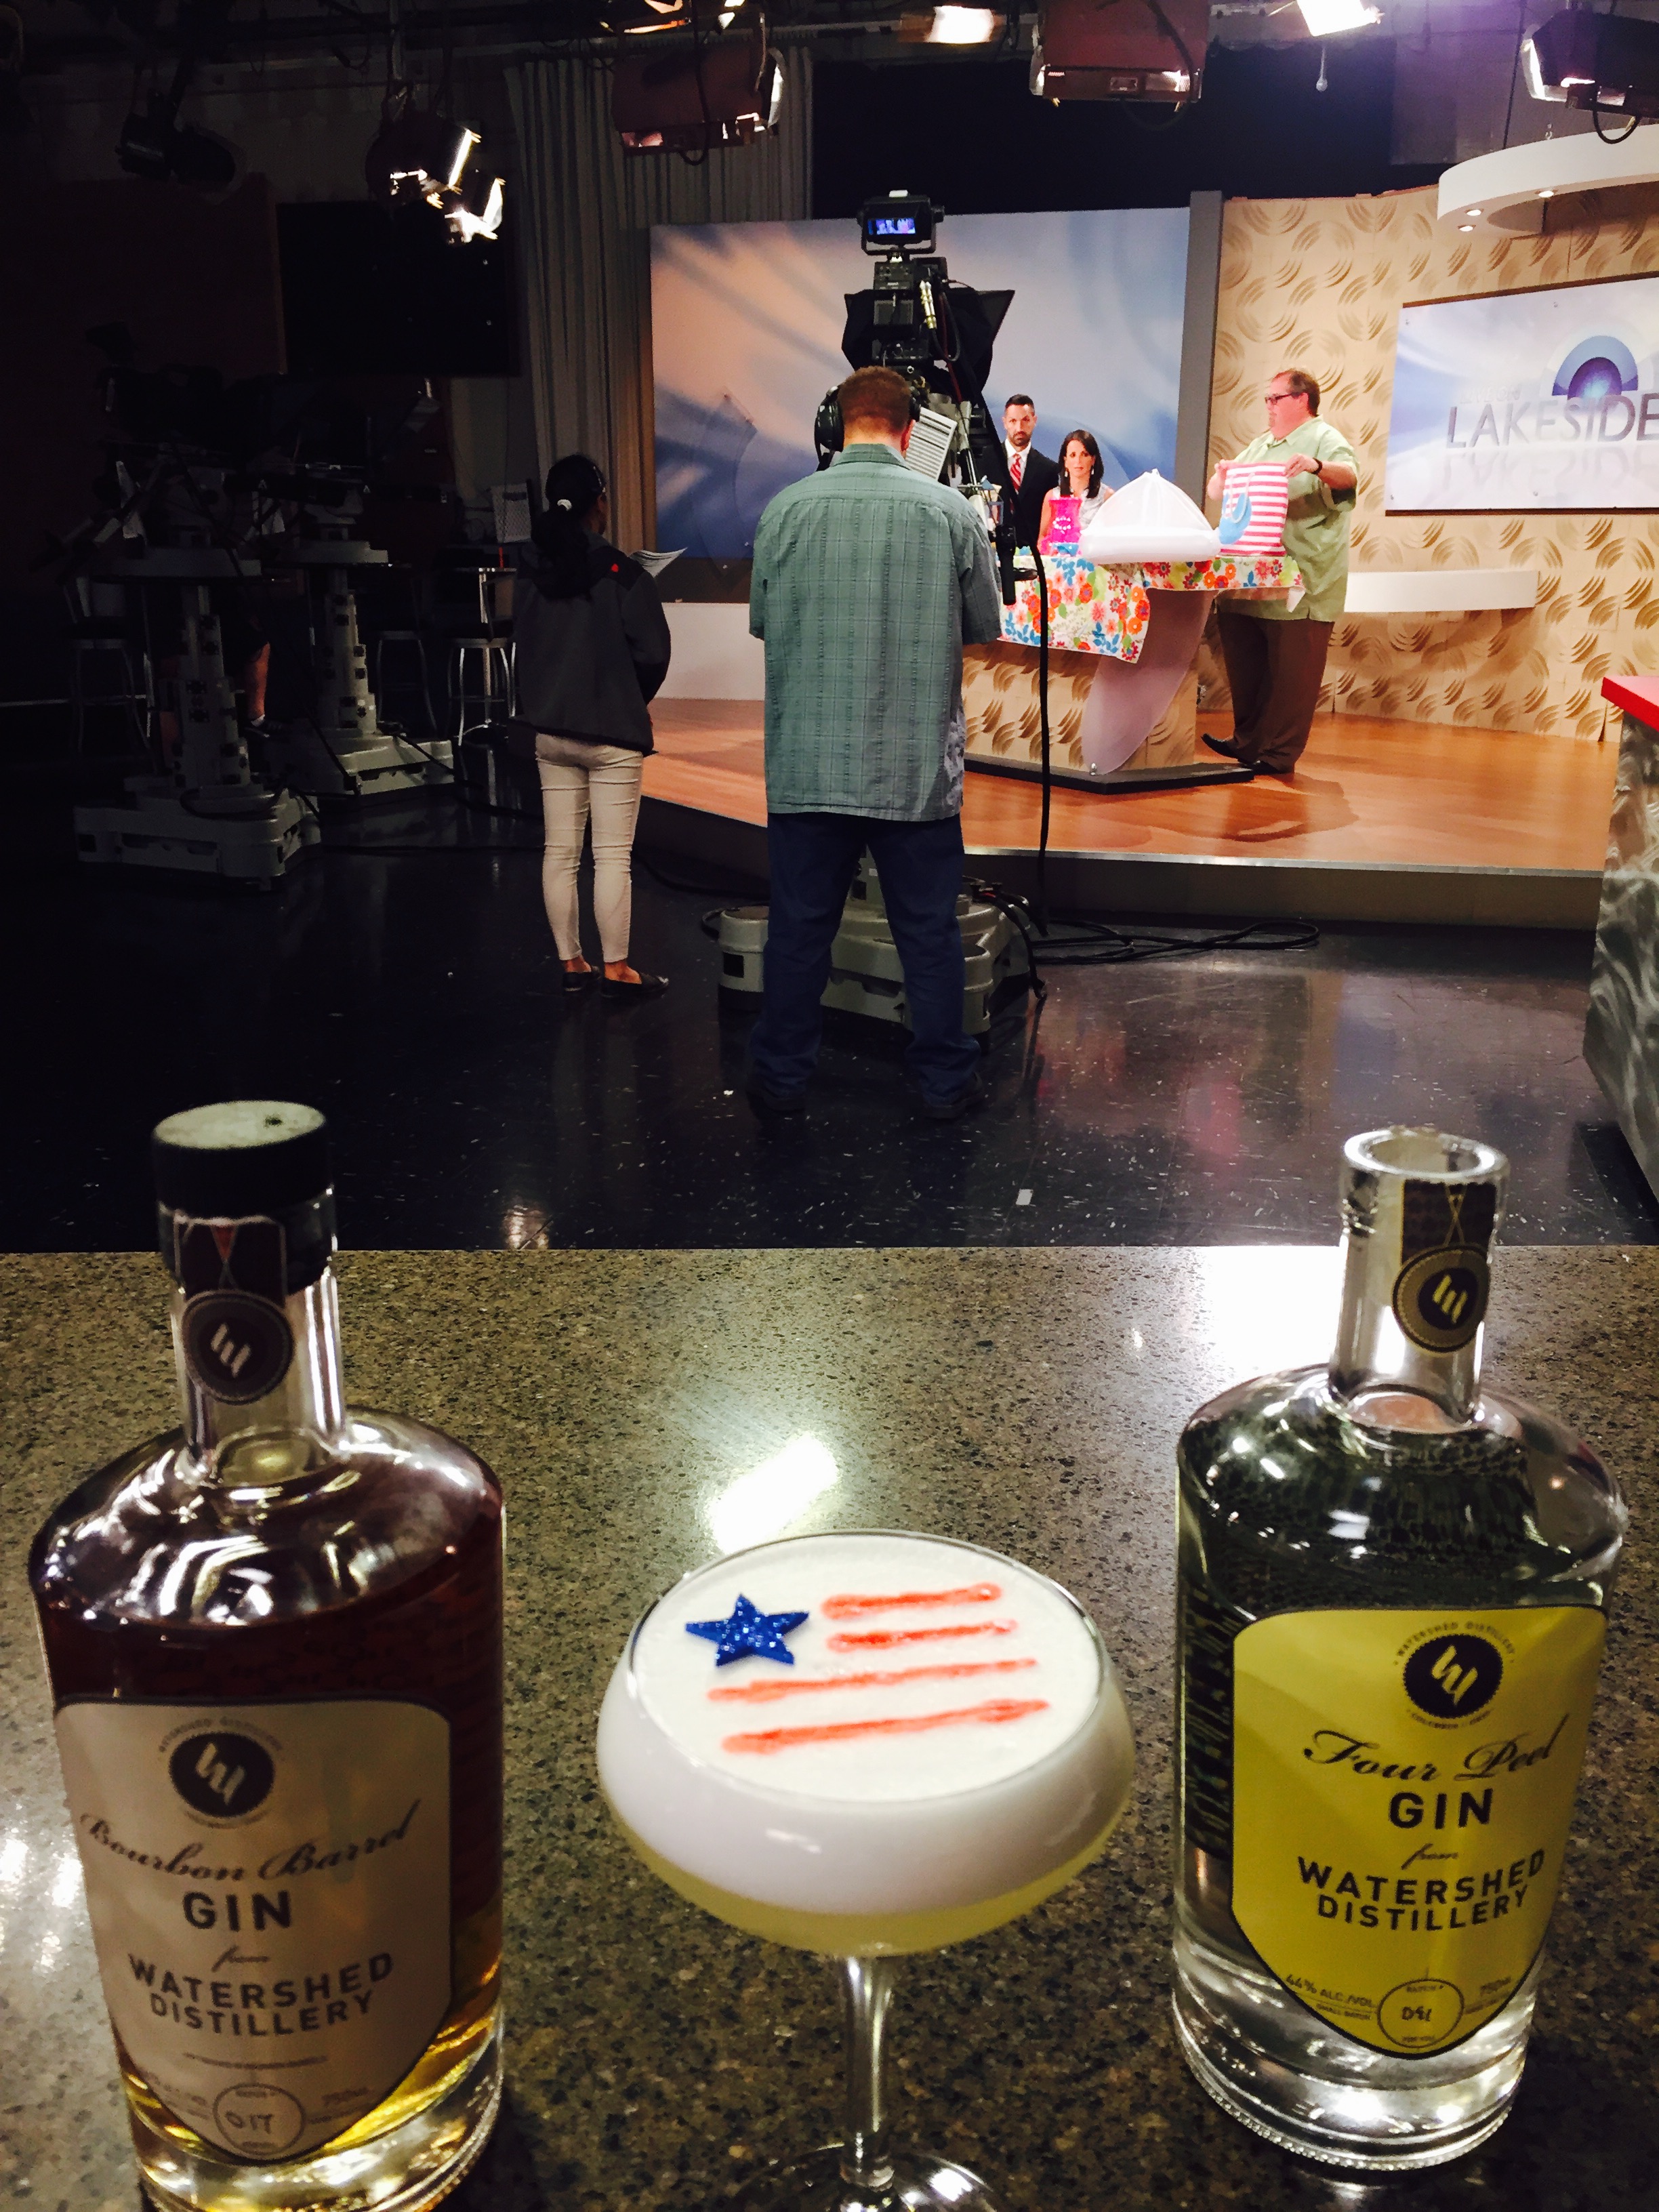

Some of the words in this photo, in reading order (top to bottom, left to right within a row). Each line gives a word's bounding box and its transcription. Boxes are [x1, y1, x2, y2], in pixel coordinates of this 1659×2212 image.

[1446, 393, 1659, 449] LAKESIDE
[1303, 1729, 1440, 1782] Four
[1389, 1788, 1494, 1830] GIN
[79, 1812, 244, 1882] Bourbon
[256, 1798, 422, 1881] Barrel
[1297, 1848, 1546, 1906] WATERSHED
[182, 1890, 292, 1932] GIN
[1317, 1884, 1528, 1931] DISTILLERY
[128, 1952, 394, 2010] WATERSHED
[150, 1989, 373, 2036] DISTILLERY
